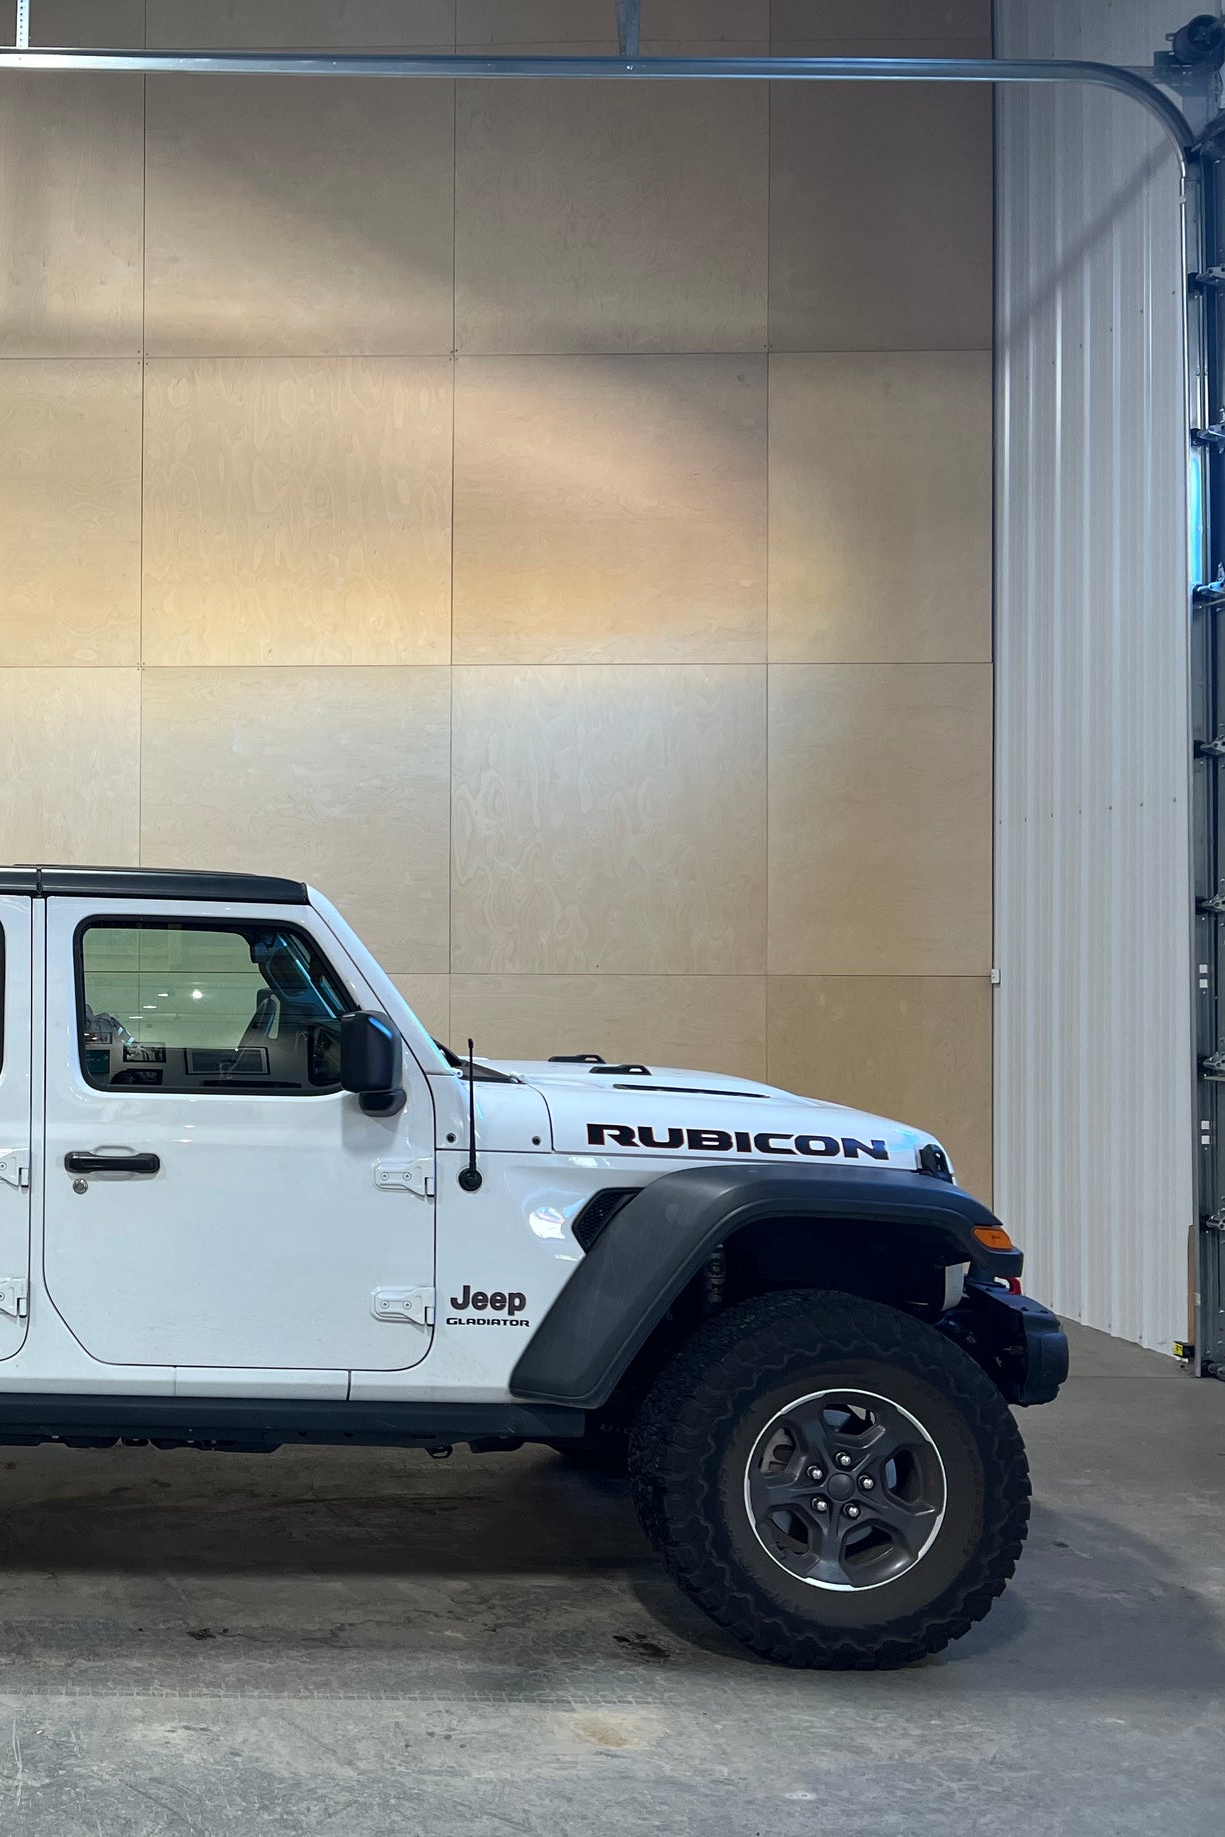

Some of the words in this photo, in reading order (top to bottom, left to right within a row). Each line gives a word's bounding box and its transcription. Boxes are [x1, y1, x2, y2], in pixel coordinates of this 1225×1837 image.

[586, 1123, 890, 1160] RUBICON
[450, 1284, 527, 1316] Jeep
[446, 1317, 531, 1327] GLADIATOR
